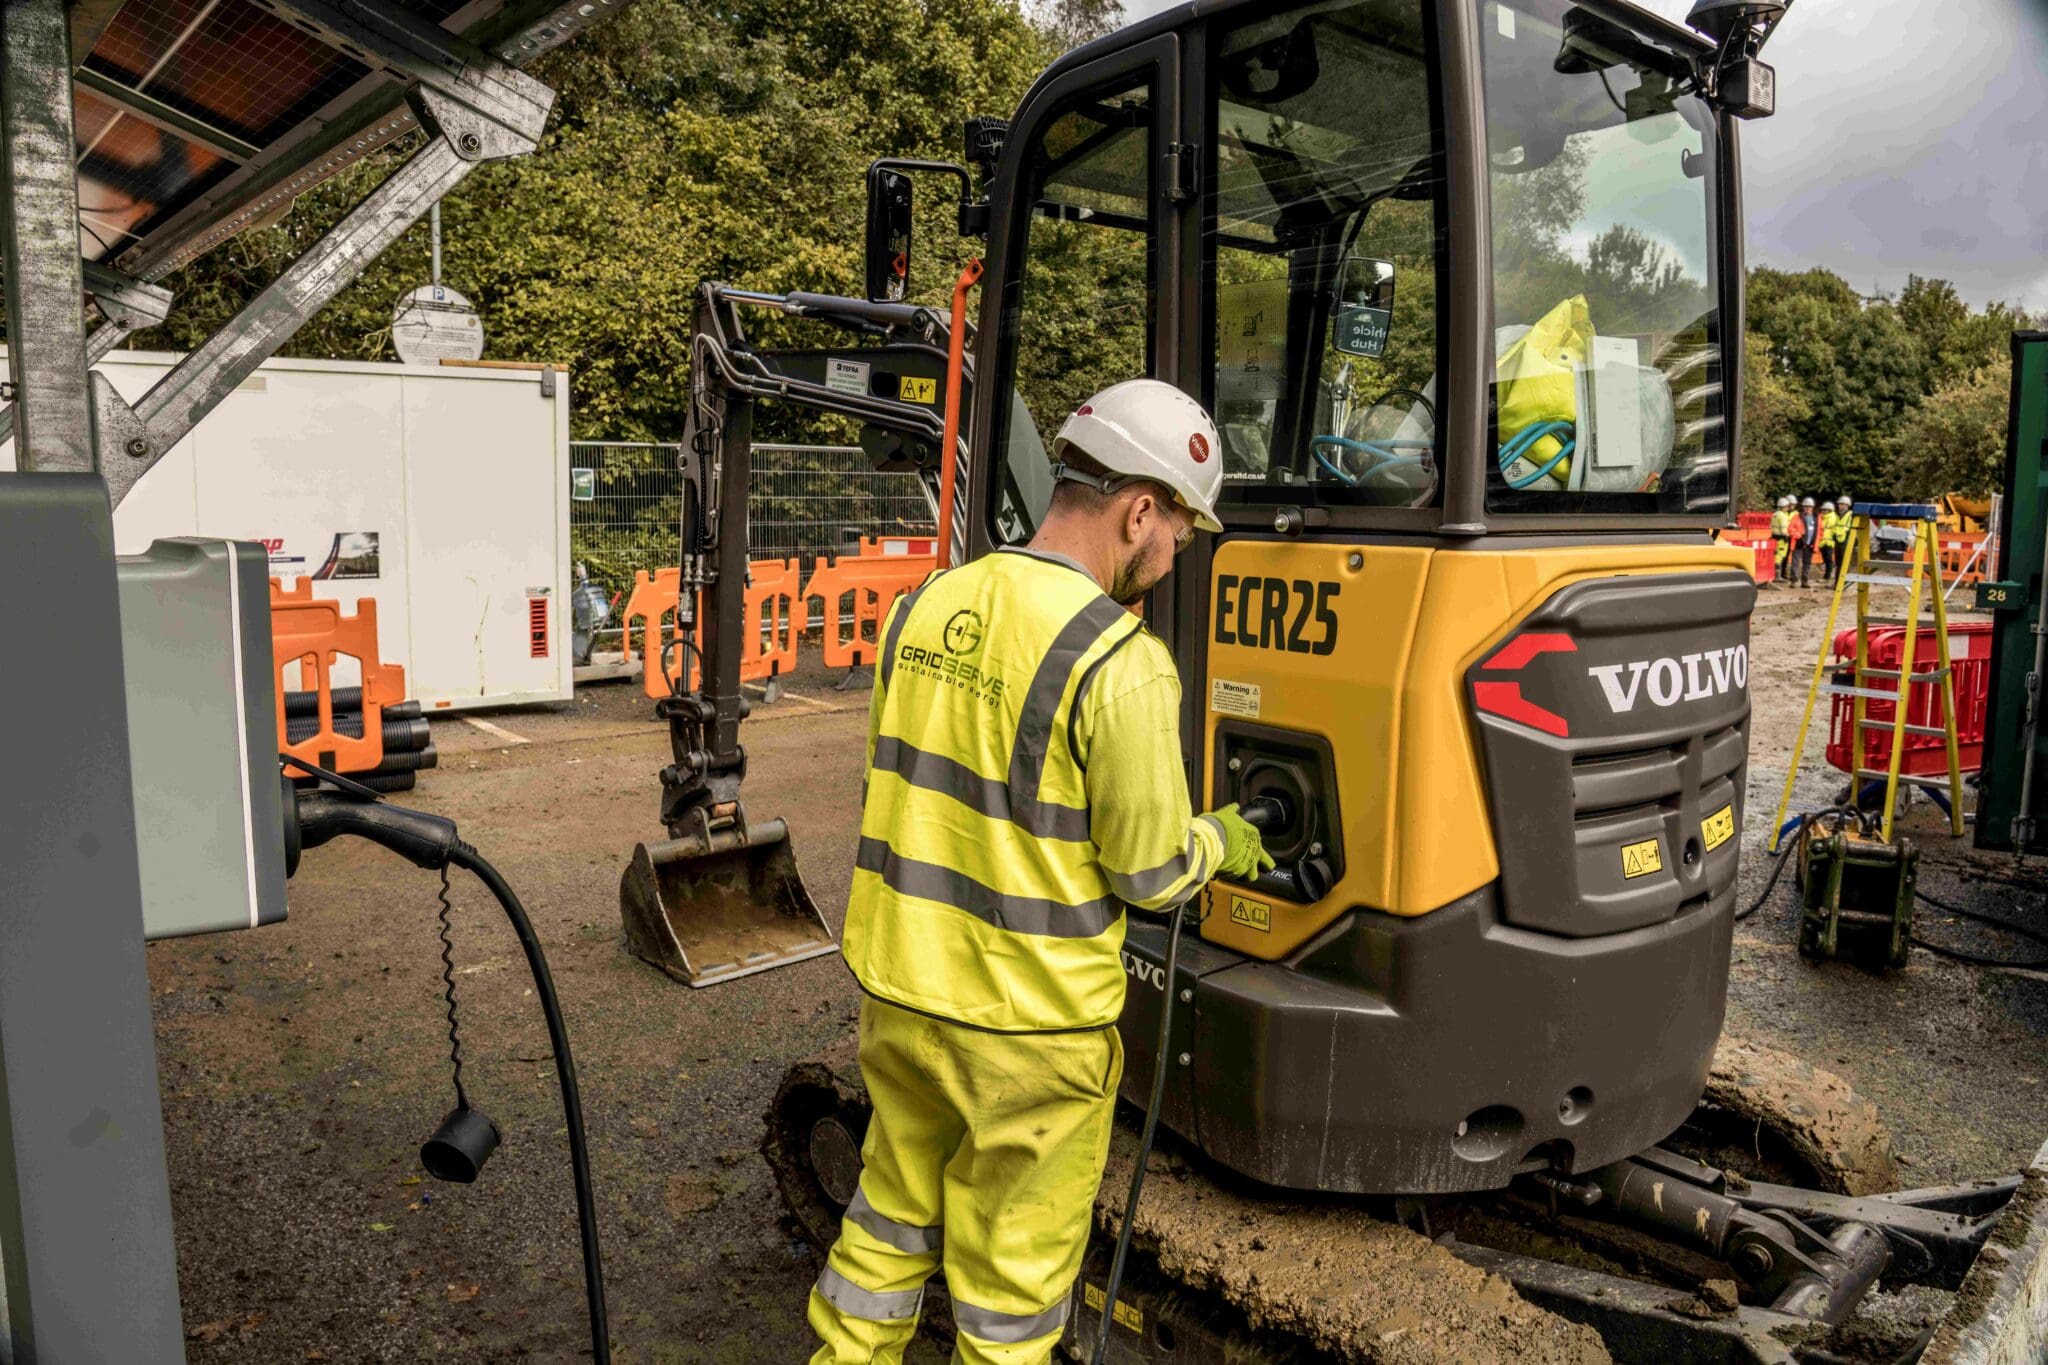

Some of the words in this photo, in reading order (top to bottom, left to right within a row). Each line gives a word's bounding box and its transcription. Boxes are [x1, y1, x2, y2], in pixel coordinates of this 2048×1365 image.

[1191, 435, 1207, 460] Visitor
[1223, 472, 1267, 480] gersltd.co.uk
[1987, 589, 2006, 601] 28
[1215, 574, 1341, 656] ECR25
[900, 645, 1004, 697] GRIDSERVE
[1588, 644, 1747, 713] VOLVO
[1223, 682, 1250, 696] Warning
[1121, 950, 1165, 991] LVO
